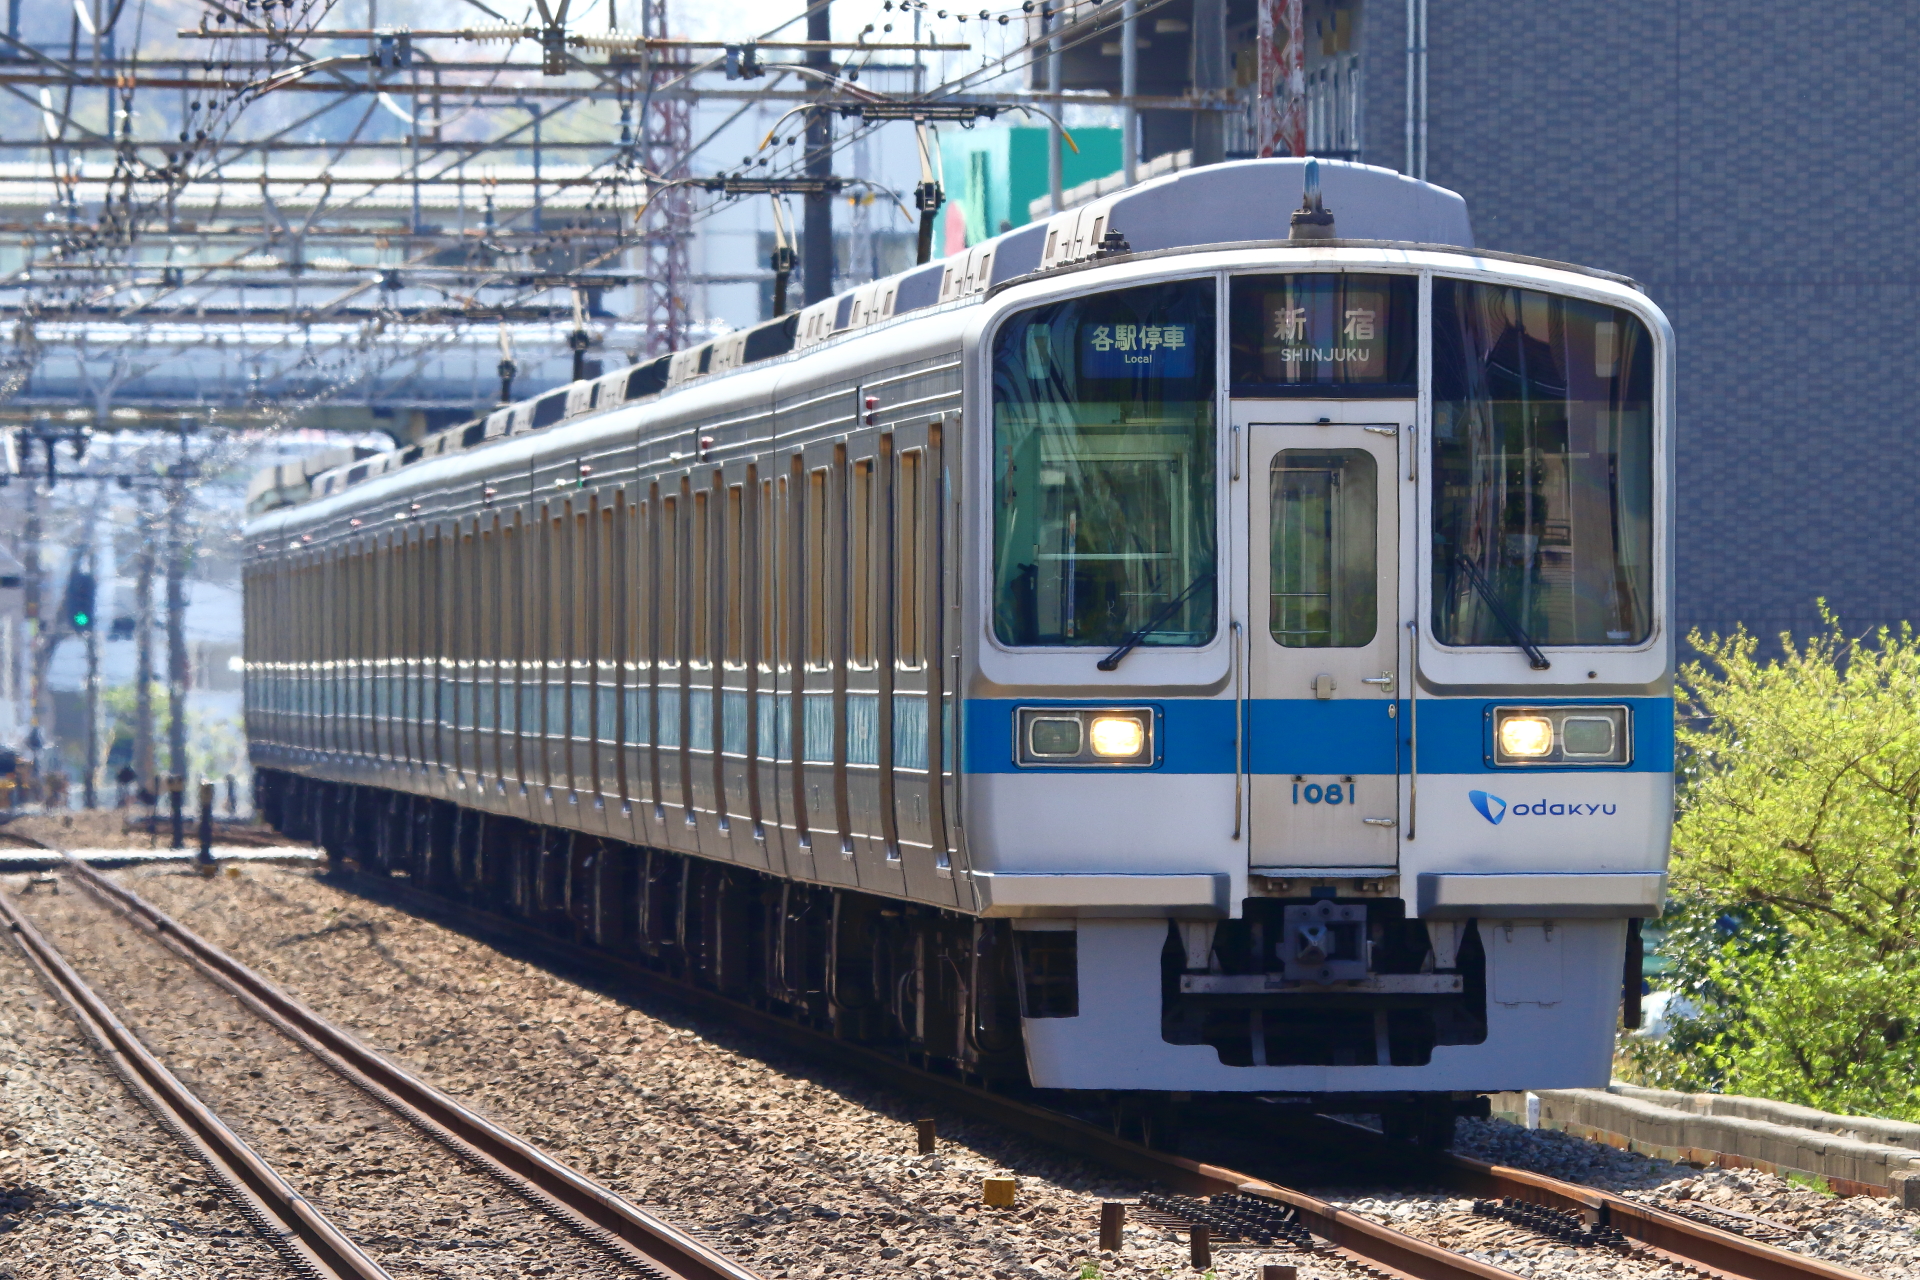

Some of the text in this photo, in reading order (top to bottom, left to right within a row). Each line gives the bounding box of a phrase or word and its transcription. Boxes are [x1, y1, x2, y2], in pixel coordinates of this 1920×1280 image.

[1273, 307, 1376, 341] 新宿
[1091, 324, 1186, 351] 各駅停車
[1124, 354, 1152, 364] Local
[1280, 348, 1370, 362] SHINJUKU
[1293, 784, 1355, 804] 1081
[1513, 799, 1617, 816] odakyu
